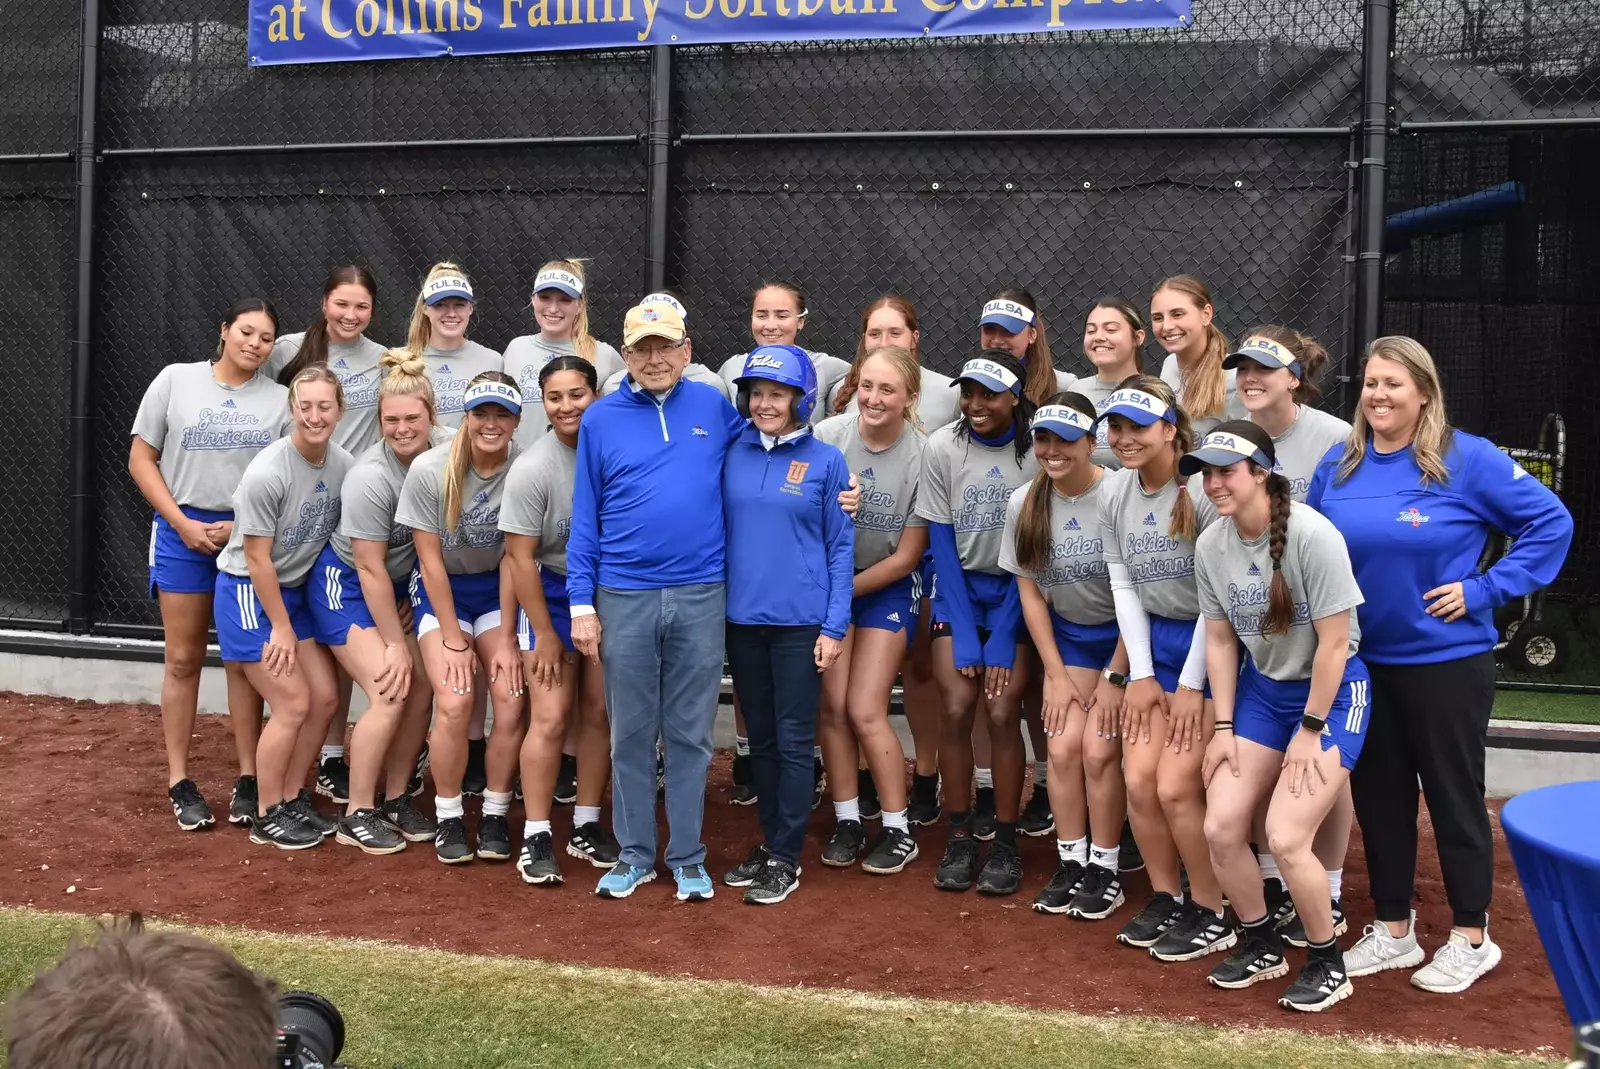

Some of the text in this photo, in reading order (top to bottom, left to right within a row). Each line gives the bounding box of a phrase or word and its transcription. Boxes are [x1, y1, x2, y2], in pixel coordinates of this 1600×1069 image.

[267, 0, 307, 42] at
[321, 0, 483, 39] Collins
[429, 279, 468, 291] TULSA
[538, 273, 577, 287] TULSA
[984, 302, 1023, 317] TULSA
[1240, 340, 1279, 356] ULSA
[747, 355, 783, 369] Tulsa
[471, 384, 515, 399] TULSA
[198, 408, 259, 431] Golden
[1034, 408, 1079, 424] TULSA
[181, 425, 271, 449] Hurricane
[1203, 435, 1236, 449] LSA
[859, 483, 895, 507] lden
[964, 483, 1016, 513] Golde
[856, 506, 905, 530] icane
[950, 507, 1007, 530] Hurric
[1125, 531, 1180, 565] Golden
[1038, 560, 1109, 583] urrica
[1128, 556, 1196, 579] urricane
[1227, 581, 1271, 613] Gold
